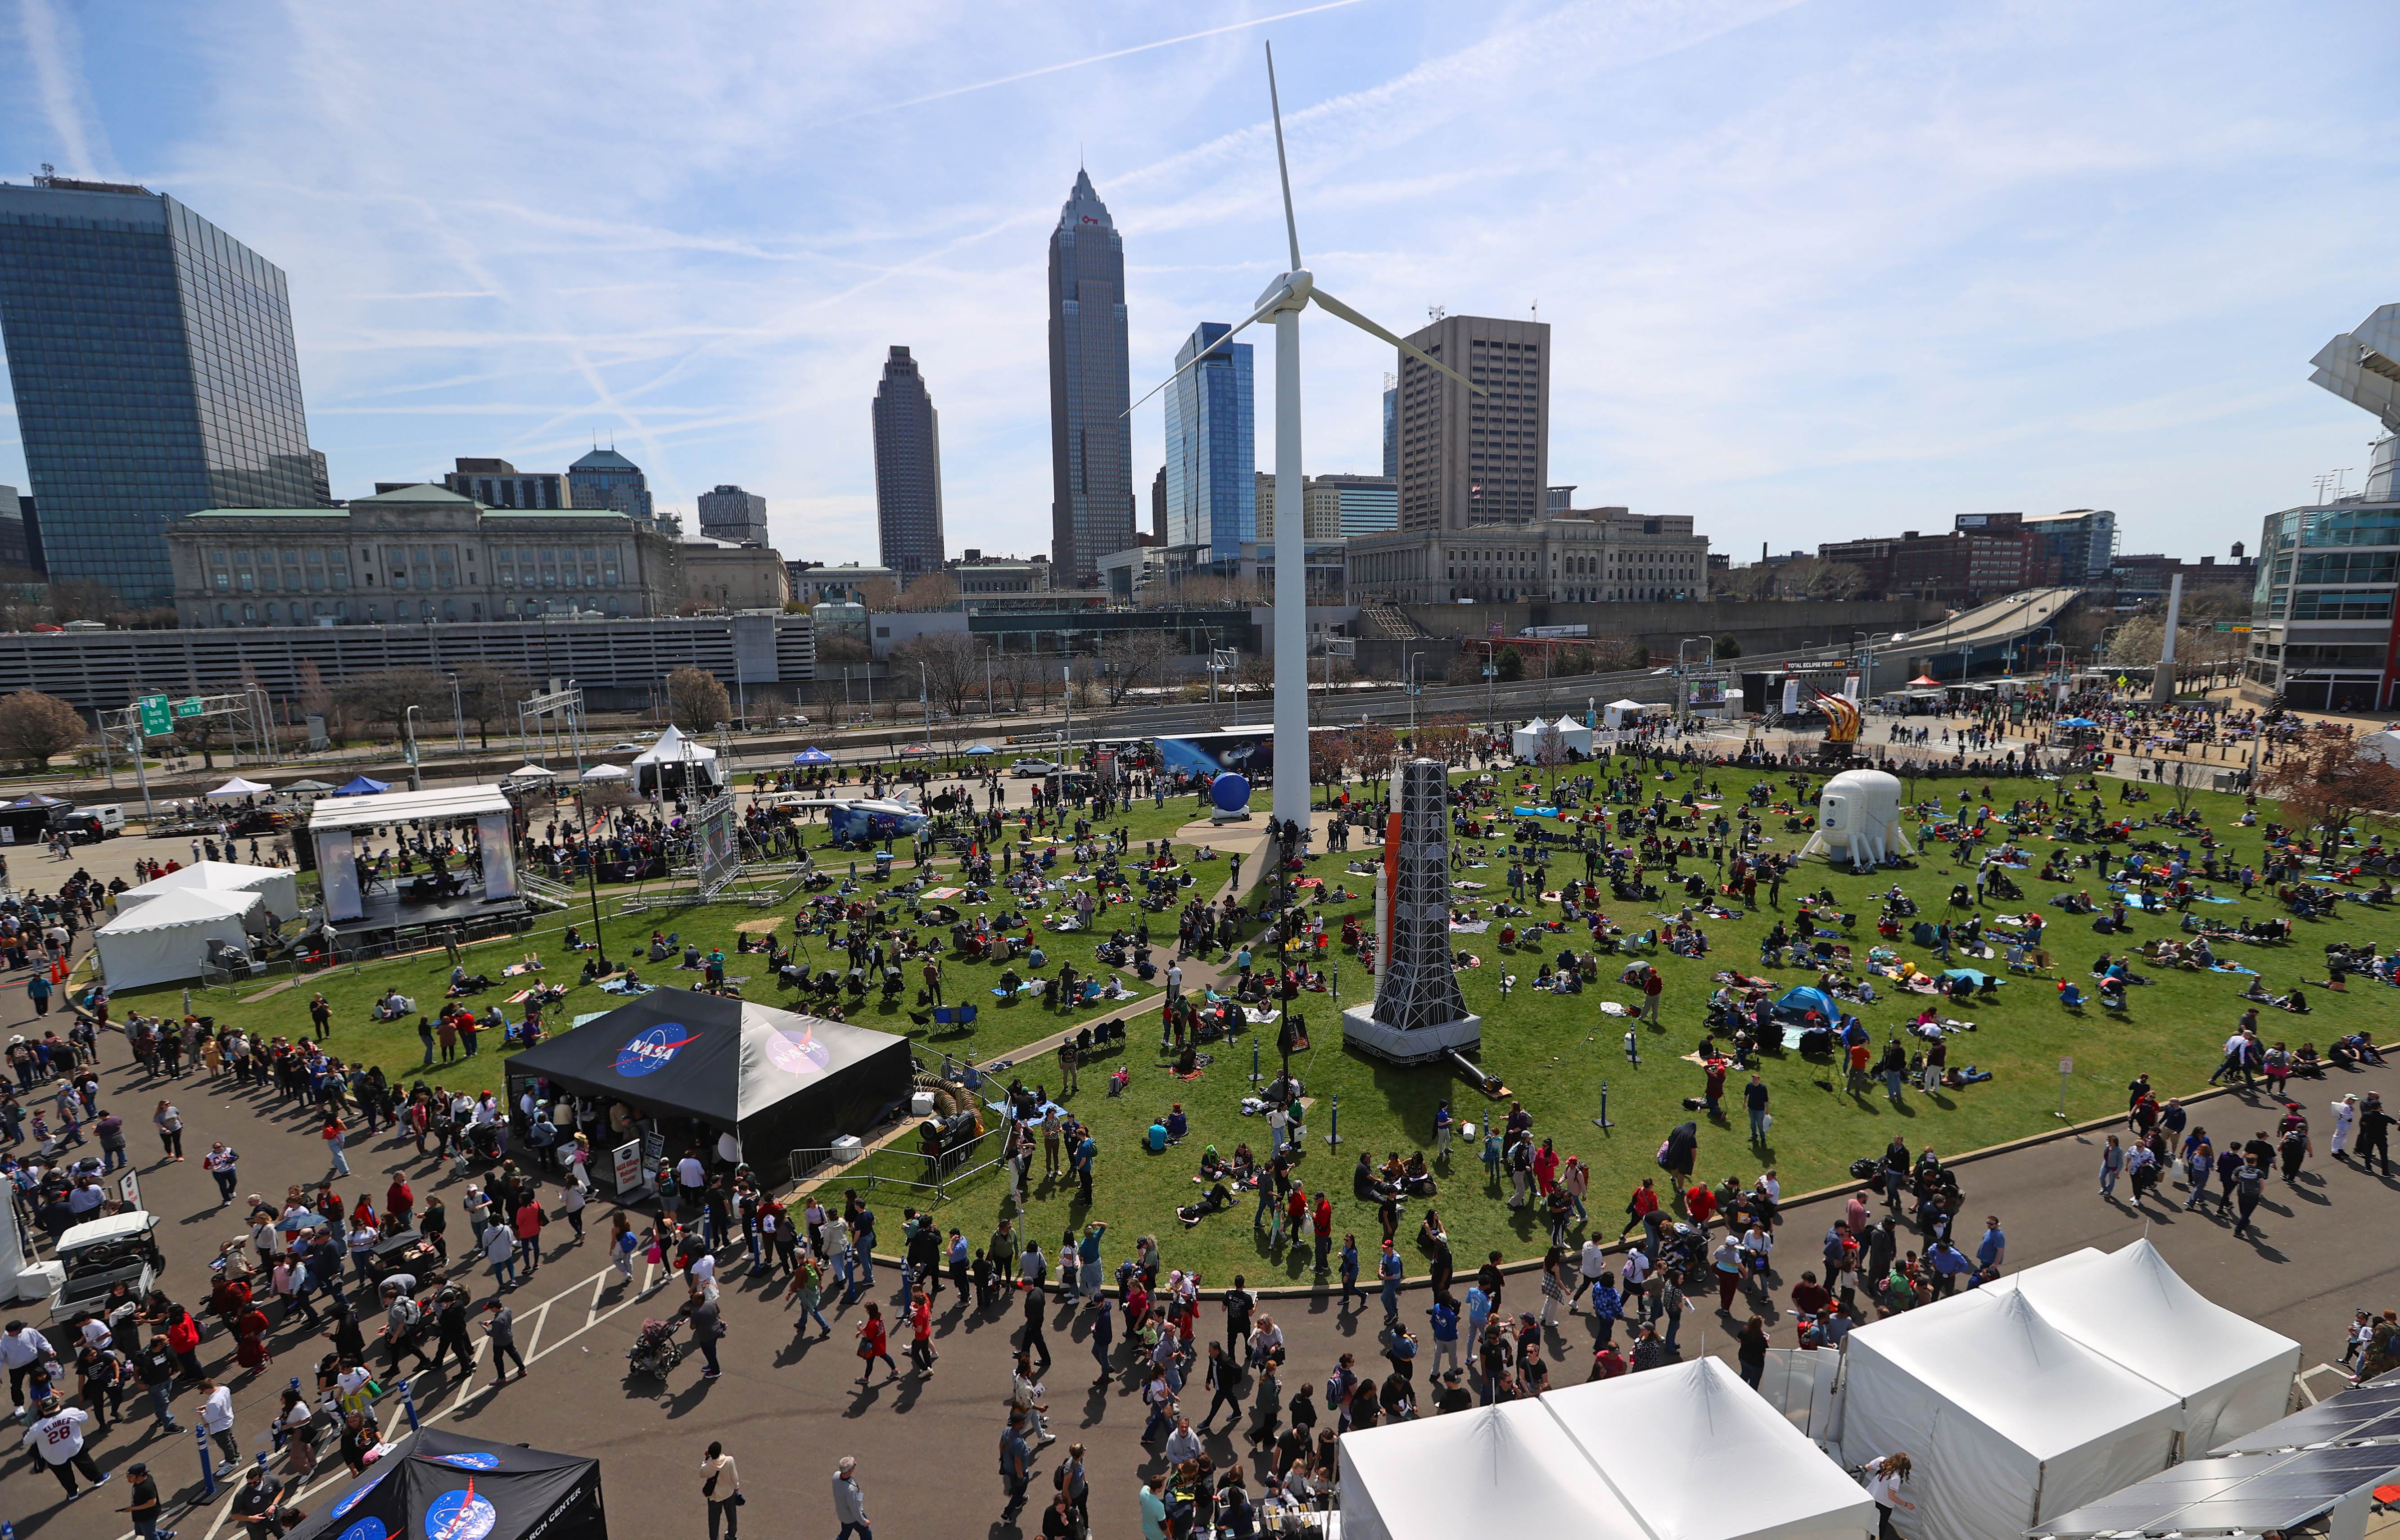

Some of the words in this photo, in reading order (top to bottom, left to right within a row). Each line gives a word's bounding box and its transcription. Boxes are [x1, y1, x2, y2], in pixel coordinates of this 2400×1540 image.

[1699, 681, 1717, 689] eclipse
[627, 1039, 674, 1060] NASA
[774, 1041, 823, 1065] NASA
[616, 1163, 626, 1172] NASA
[1471, 1299, 1480, 1311] 17
[43, 1417, 71, 1433] KLUBER
[47, 1426, 70, 1445] 28
[549, 1487, 581, 1522] CENTER
[434, 1500, 488, 1540] NASA
